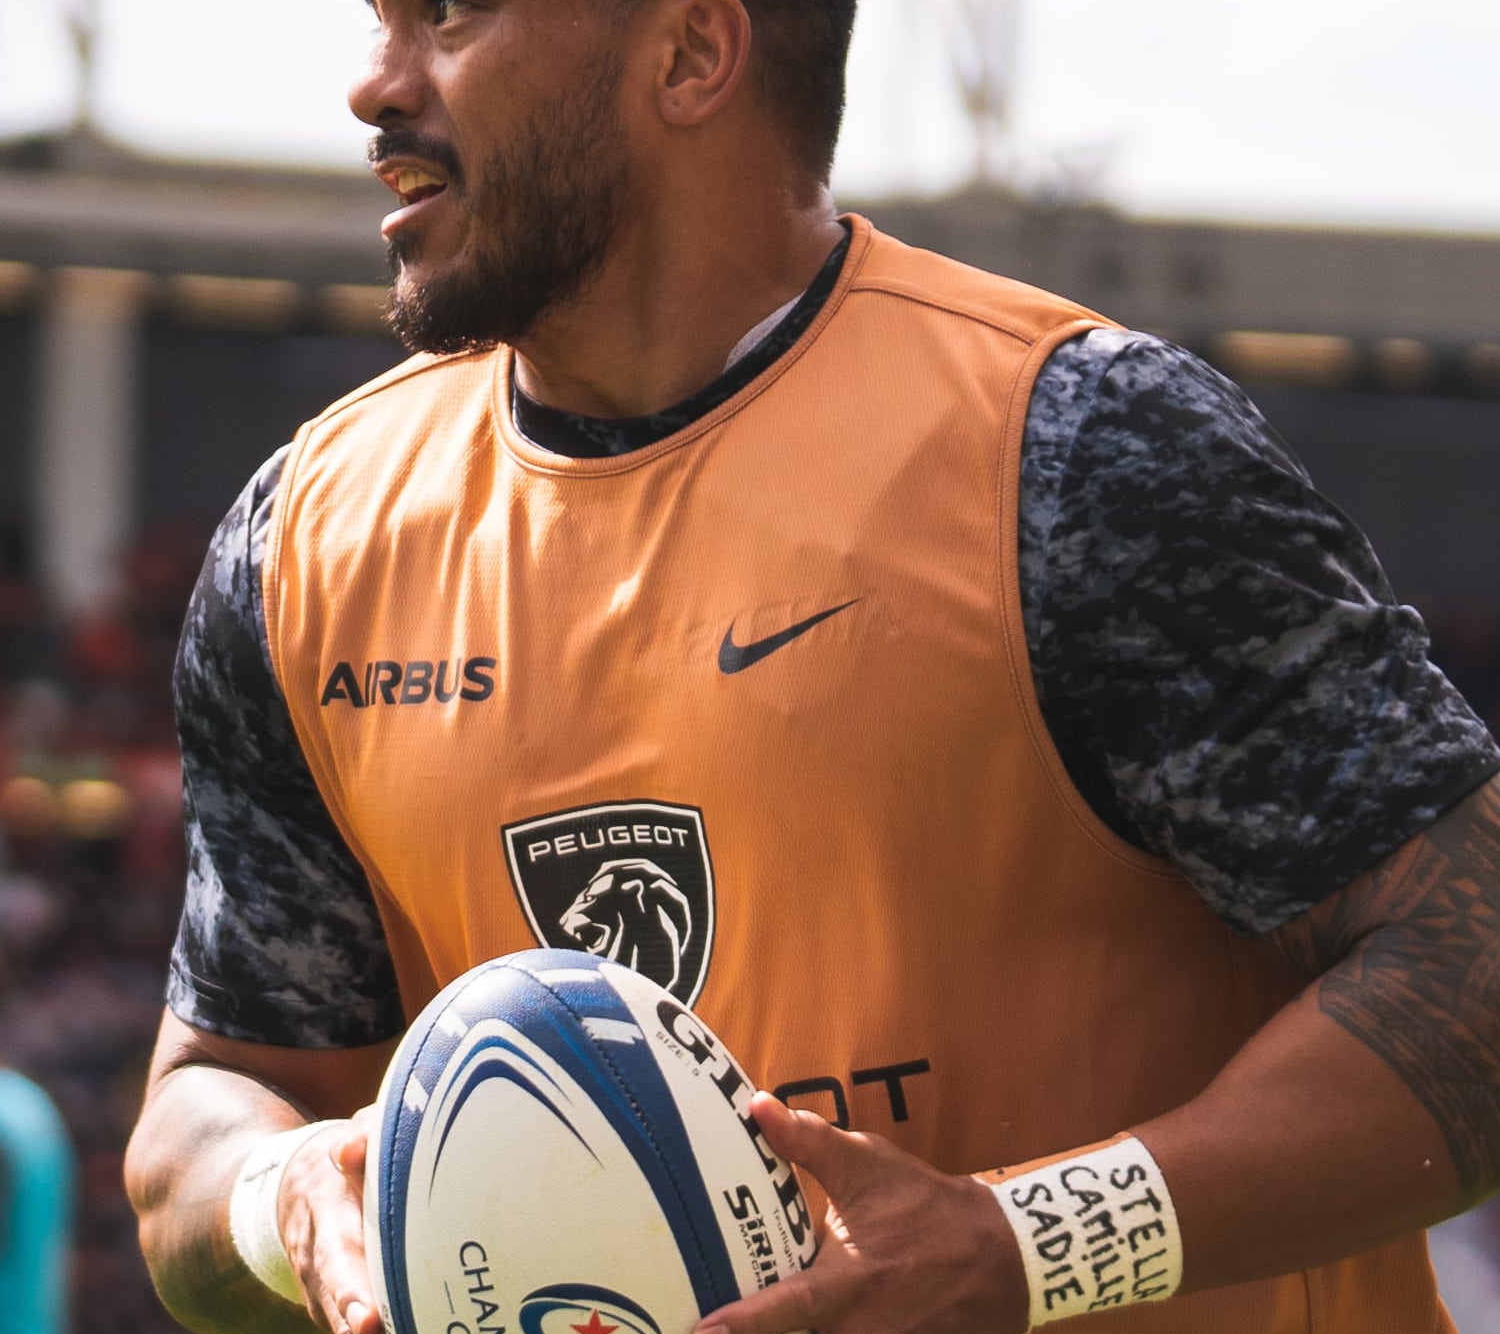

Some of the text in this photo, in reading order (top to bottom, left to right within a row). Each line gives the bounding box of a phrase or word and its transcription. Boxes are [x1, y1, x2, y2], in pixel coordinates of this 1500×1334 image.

[320, 656, 498, 709] AIRBUS
[528, 824, 689, 863] PEUGEOT
[1010, 1182, 1085, 1311] SADIE
